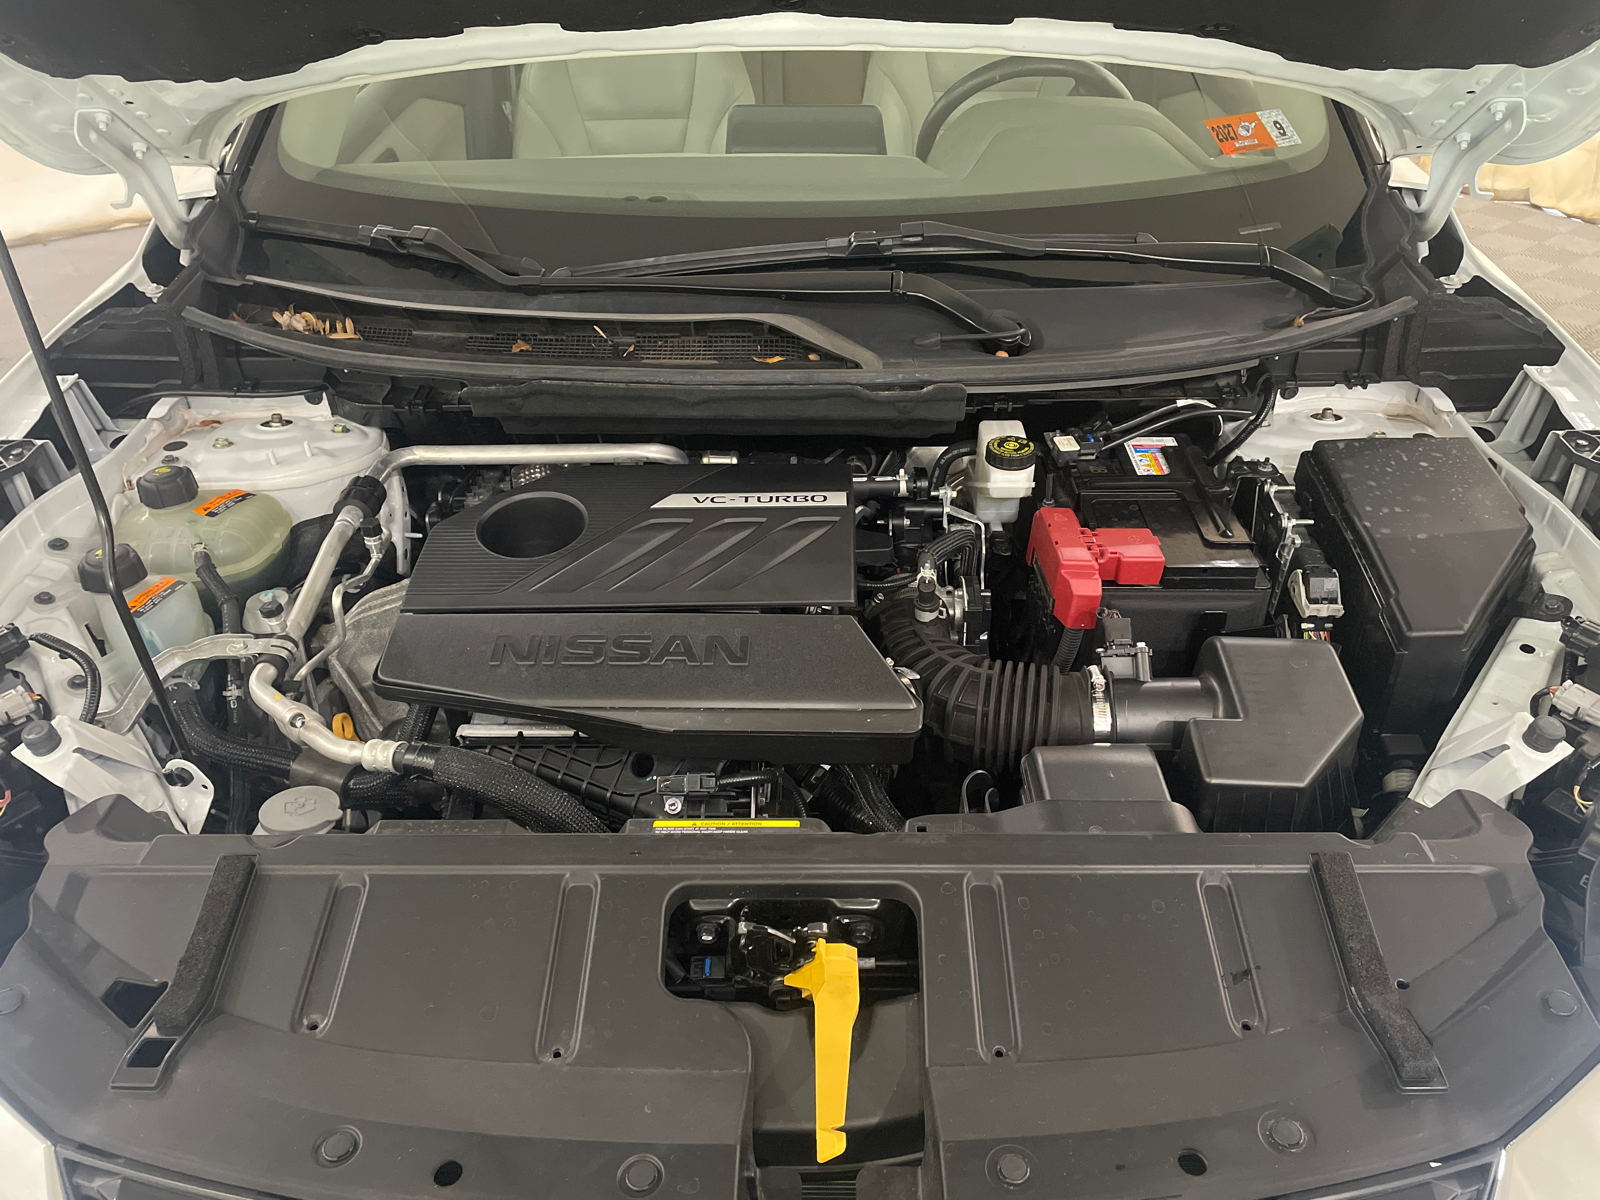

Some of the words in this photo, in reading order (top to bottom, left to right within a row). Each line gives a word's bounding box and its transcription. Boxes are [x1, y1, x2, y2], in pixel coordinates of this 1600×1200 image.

[1211, 123, 1238, 142] 2027
[1273, 120, 1287, 136] 9
[692, 494, 828, 504] VC-TURBO
[488, 634, 750, 666] NISSAN
